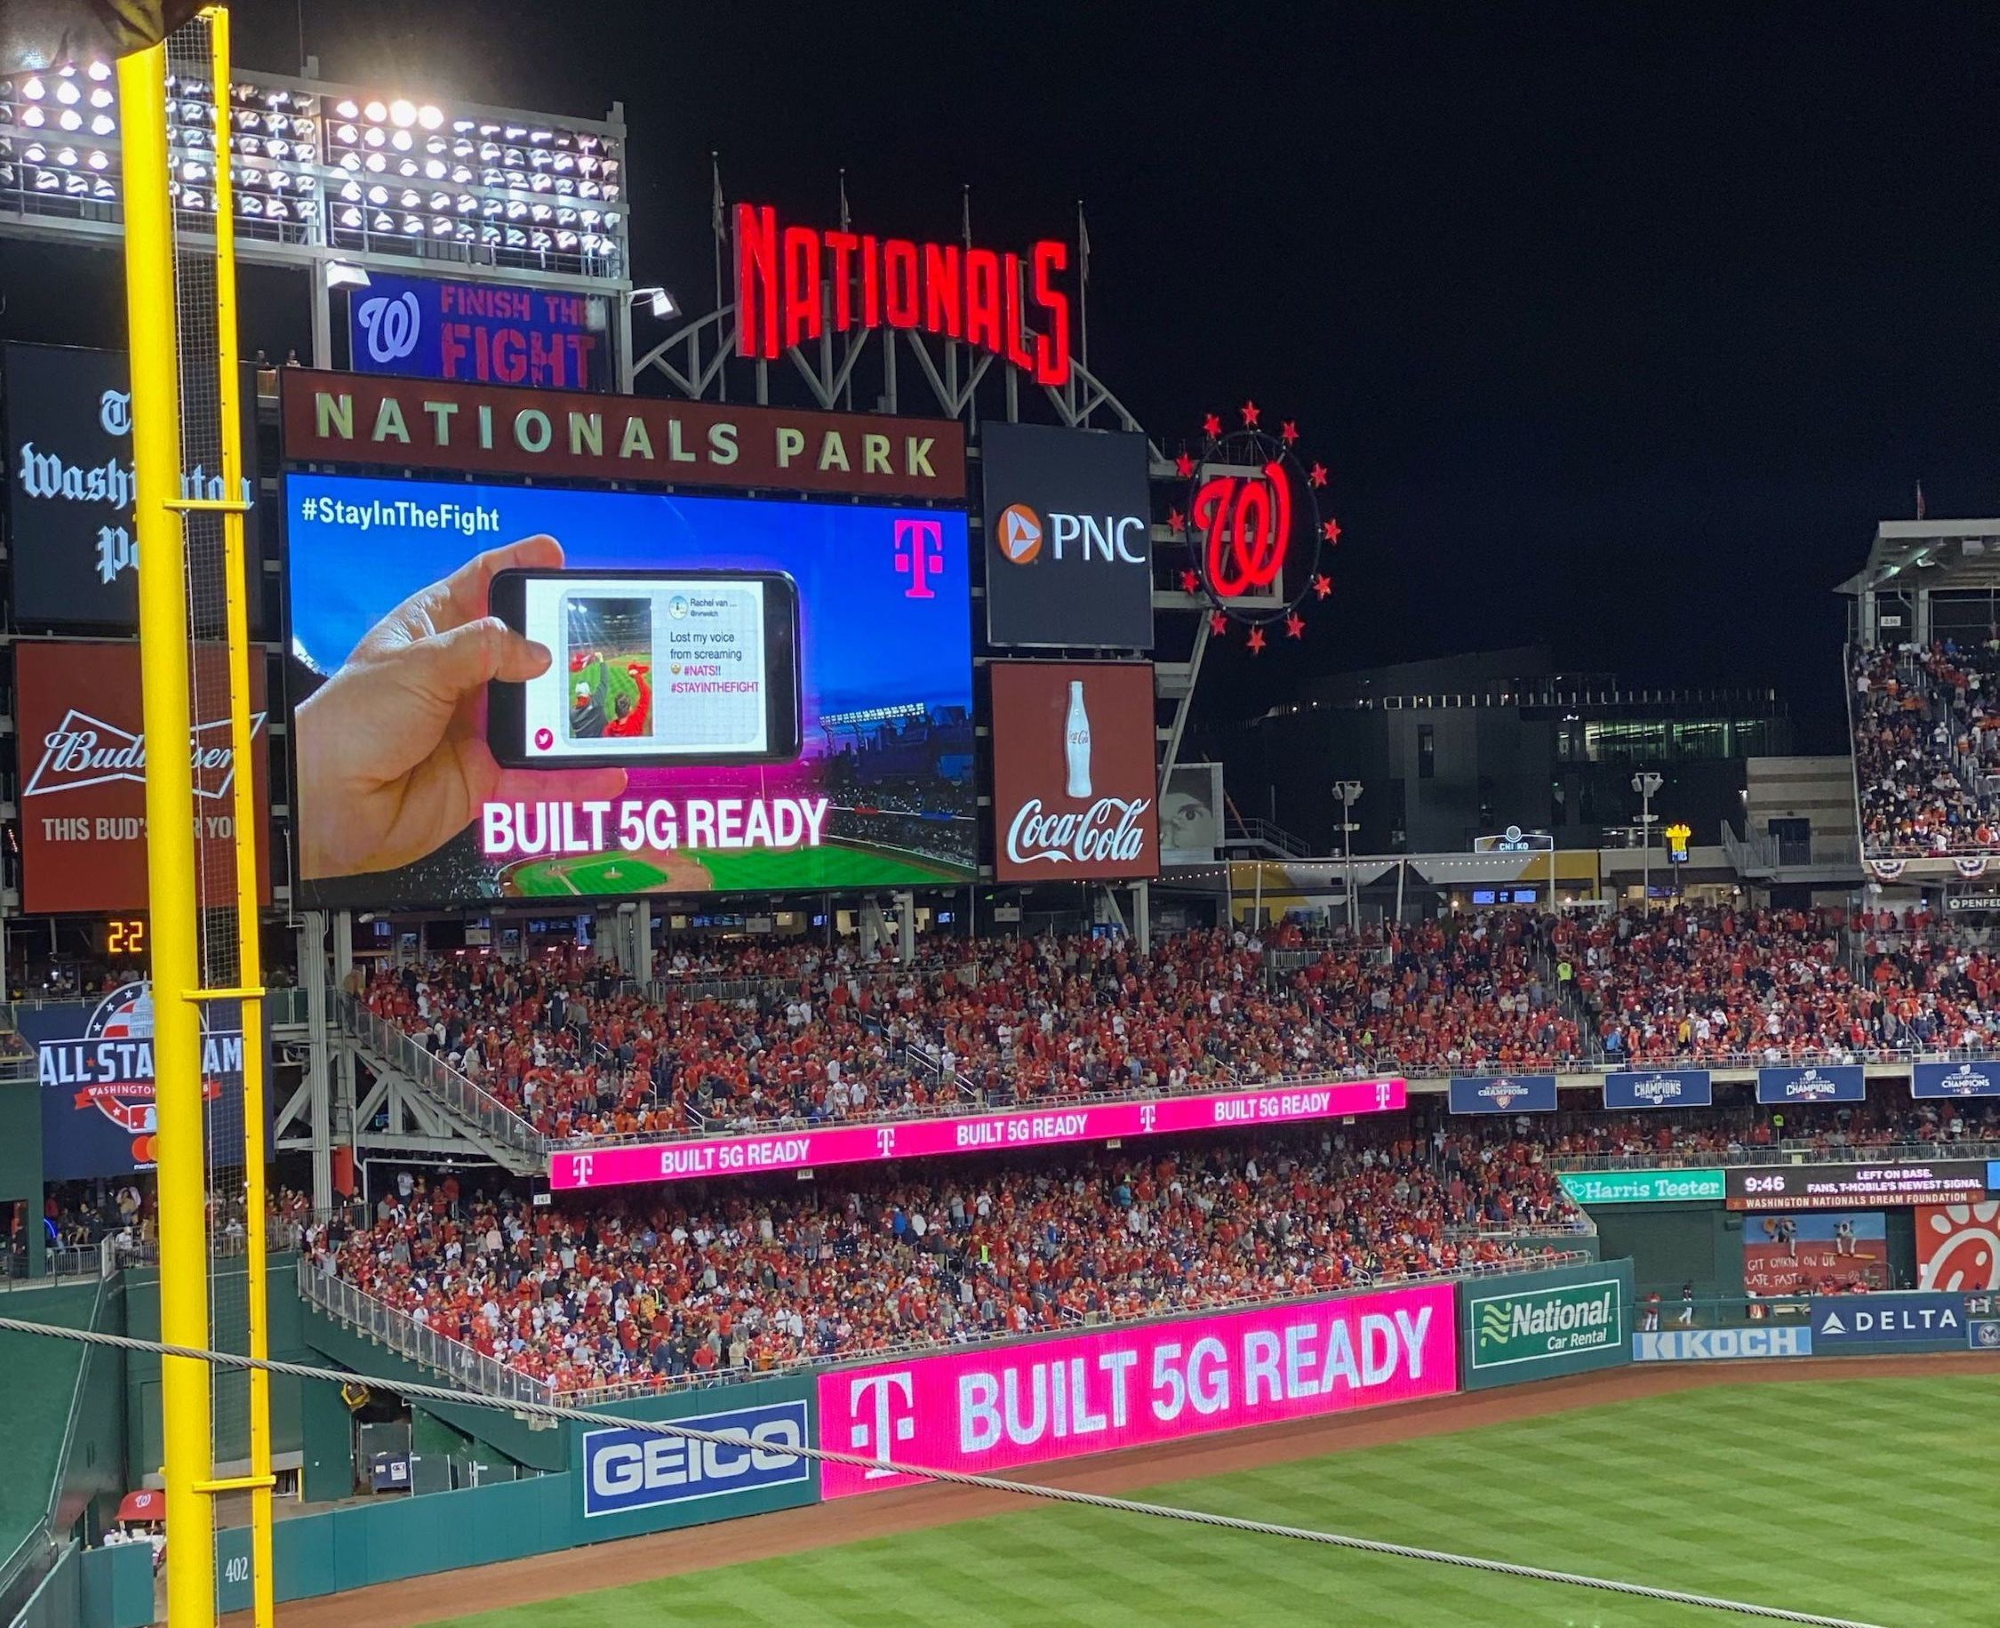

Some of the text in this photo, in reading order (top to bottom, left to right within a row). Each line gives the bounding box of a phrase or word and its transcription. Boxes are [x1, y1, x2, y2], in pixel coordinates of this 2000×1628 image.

[441, 285, 531, 321] FINISH
[735, 203, 1070, 386] NATIONALS
[442, 323, 596, 389] FIGHT
[316, 392, 938, 477] NATIONALS PARK
[302, 498, 499, 535] #StayInTheFight
[1049, 513, 1146, 563] PNC
[690, 598, 714, 607] Rachel
[670, 631, 734, 645] Lost my voice
[670, 648, 742, 661] from screaming
[684, 665, 721, 676] #NATS!!
[671, 681, 759, 693] #STAYINTHEFIGHT
[42, 818, 90, 841] THIS
[483, 798, 828, 853] BUILT 5G READY
[1007, 798, 1151, 863] Coca-Cola
[39, 1046, 91, 1085] ALL
[1634, 1082, 1682, 1097] CHAMPIONS
[1786, 1083, 1836, 1095] CHAMPIONS
[1941, 1079, 1990, 1088] CHAMPIONS
[1215, 1092, 1330, 1121] BUILT 5G READY
[957, 1114, 1088, 1146] BUILT 5G READY
[661, 1138, 811, 1174] BUILT 5G READY
[1745, 1176, 1785, 1192] 9:46
[1807, 1178, 1982, 1194] FANS, T-MOBILE'S NEWEST SIGNAL
[1857, 1168, 1933, 1181] LEFT ON BASE.
[1585, 1179, 1720, 1199] Harris Teeter
[1746, 1192, 1967, 1208] WASHINGTON NATIONALS DREAM FOUNDATION
[1747, 1259, 1764, 1271] GIT
[1803, 1256, 1817, 1267] ON
[1856, 1309, 1958, 1332] DELTA
[1547, 1327, 1607, 1350] Car Rental
[1680, 1327, 1800, 1358] KOCH
[959, 1307, 1432, 1454] BUILT 5G READY
[593, 1419, 800, 1496] GEICO
[225, 1556, 249, 1583] 402
